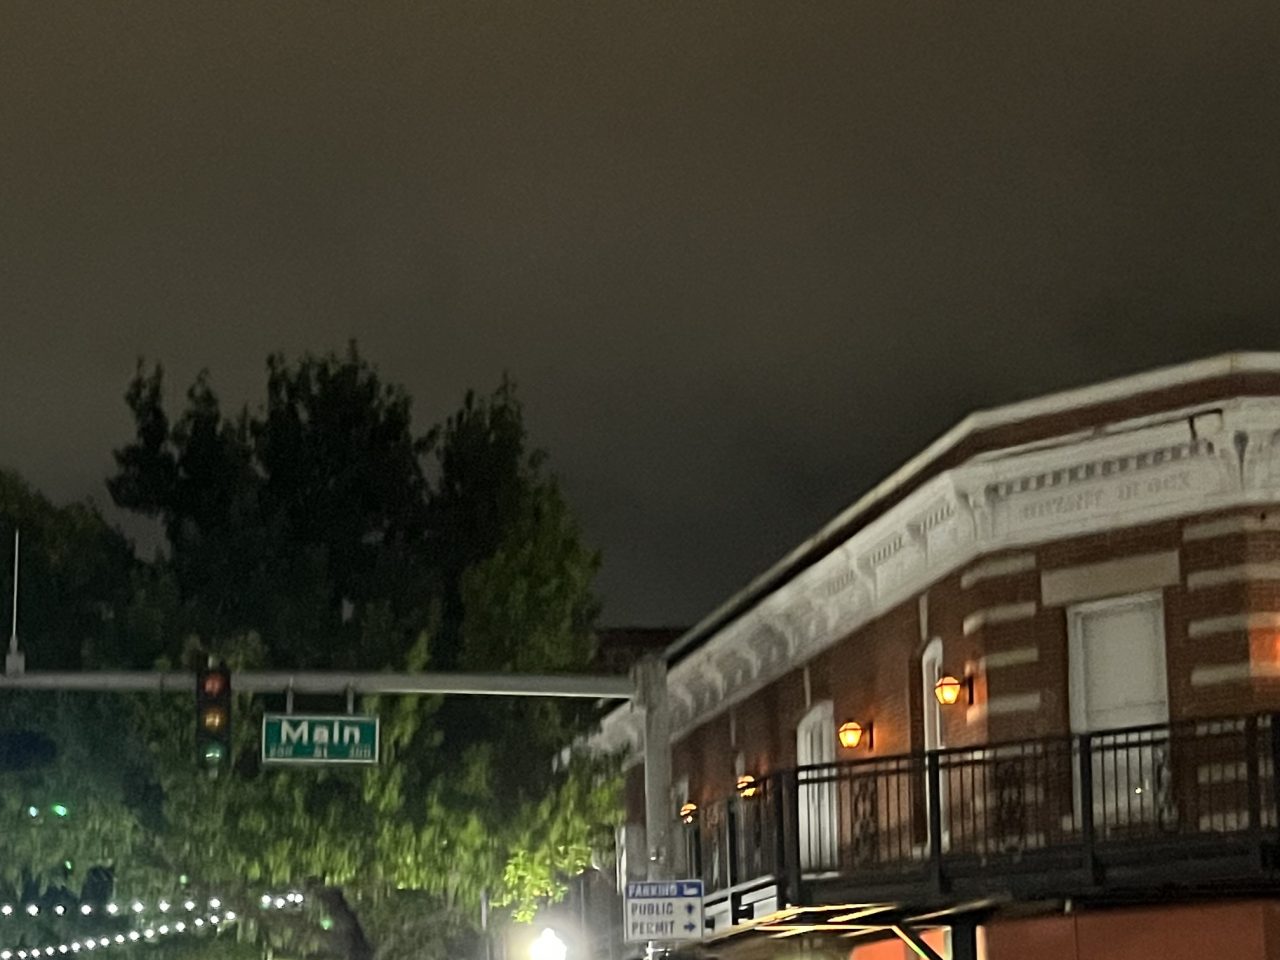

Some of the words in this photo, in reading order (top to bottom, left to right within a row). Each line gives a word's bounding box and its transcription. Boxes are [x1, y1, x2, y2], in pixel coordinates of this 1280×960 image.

[281, 720, 360, 745] Main
[628, 884, 678, 898] PARKING
[631, 902, 674, 916] PUBLIC
[631, 920, 675, 935] PERMIT
